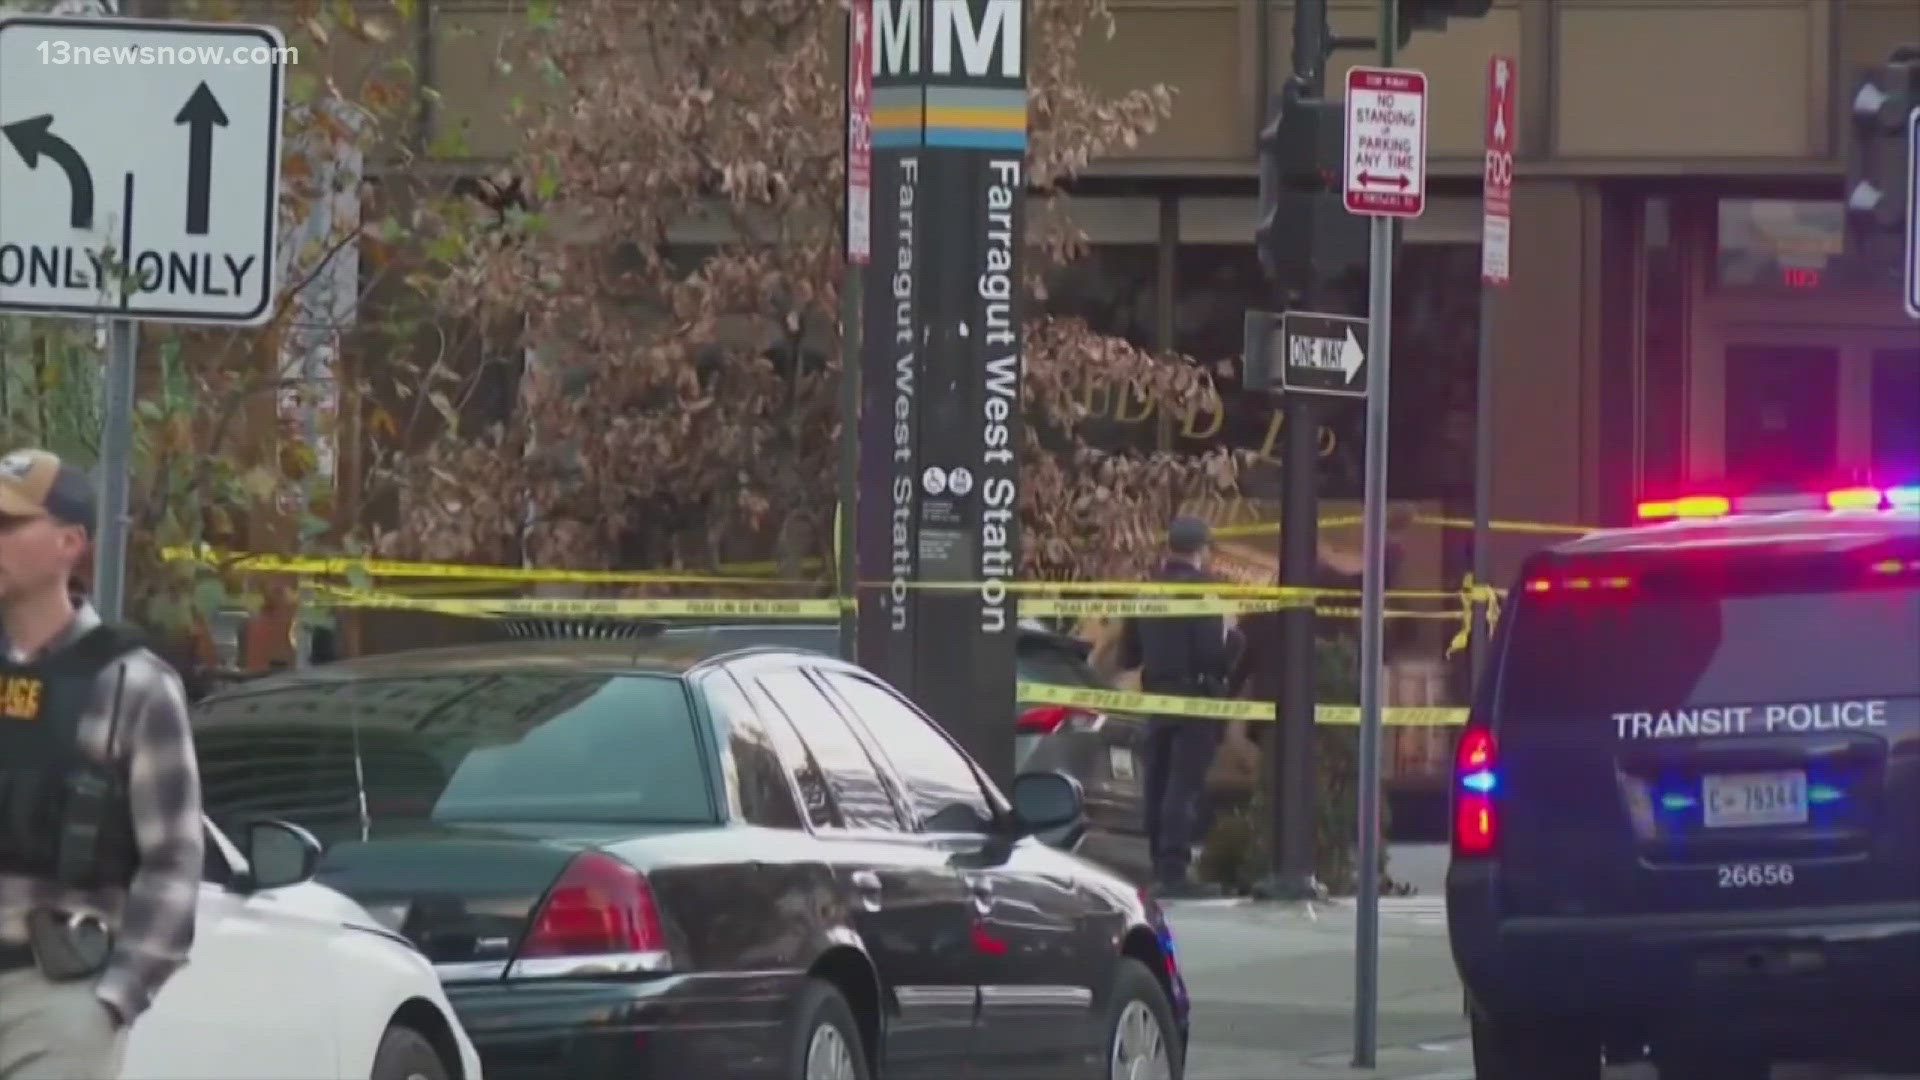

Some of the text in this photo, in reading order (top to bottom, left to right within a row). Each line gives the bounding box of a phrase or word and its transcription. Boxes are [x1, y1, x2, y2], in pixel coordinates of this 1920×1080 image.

[872, 0, 920, 76] M
[932, 0, 1021, 76] M
[1356, 107, 1415, 127] STANDING
[1377, 94, 1394, 107] NO
[1355, 152, 1414, 170] ANY TIME
[1358, 135, 1411, 152] PARKING
[0, 244, 104, 289] ONLY
[136, 251, 255, 297] ONLY
[1292, 334, 1344, 369] ONE WAY
[892, 157, 918, 630] Farragut West Station
[978, 160, 1020, 632] Farragut West Station
[1612, 700, 1888, 739] TRANSIT POLICE
[1718, 864, 1795, 887] 26656
